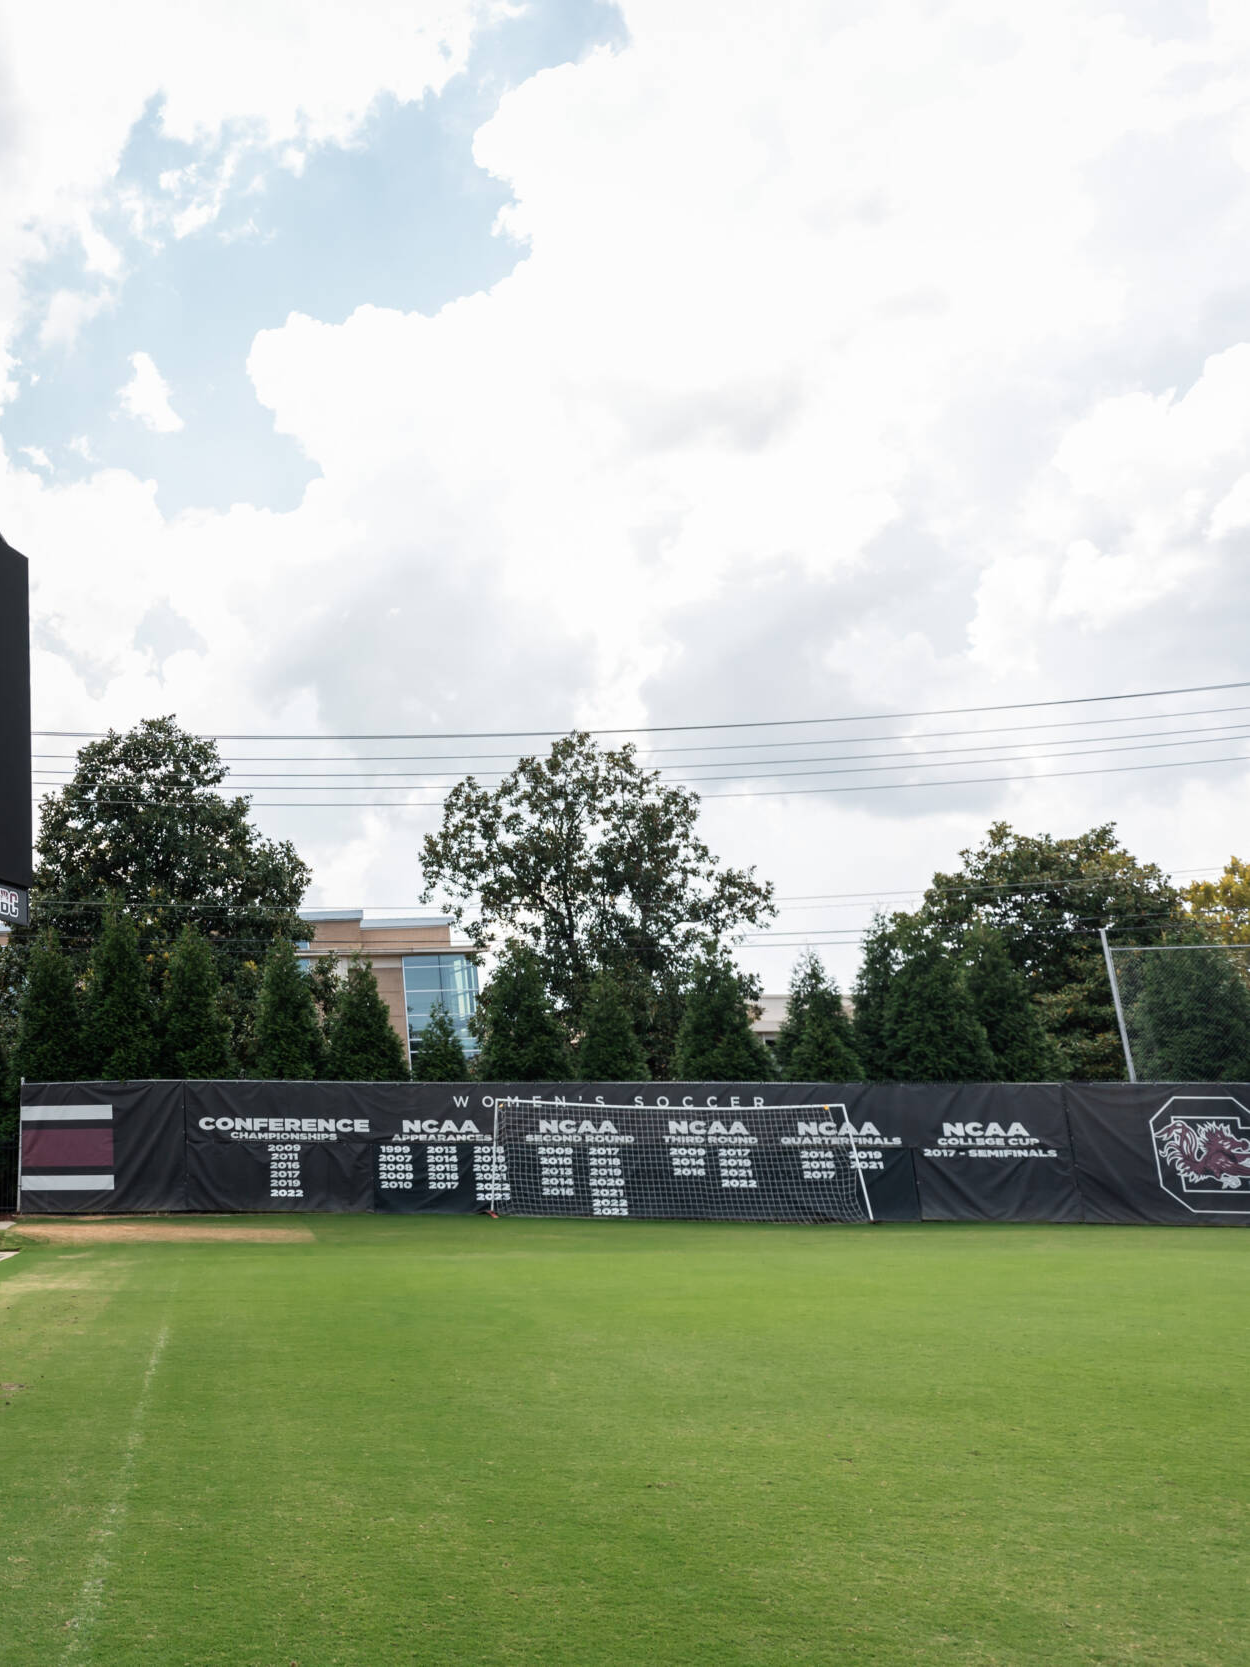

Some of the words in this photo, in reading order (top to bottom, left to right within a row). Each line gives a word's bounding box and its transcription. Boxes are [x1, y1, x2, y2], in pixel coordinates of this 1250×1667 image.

[453, 1096, 606, 1108] WOMEN'S
[634, 1096, 765, 1108] SOCCER
[199, 1117, 370, 1133] CONFERENCE
[402, 1119, 480, 1133] NCAA
[539, 1120, 618, 1134] NCAA
[668, 1121, 749, 1135] NCAA
[797, 1122, 881, 1136] NCAA
[942, 1122, 1030, 1137] NCAA
[230, 1132, 338, 1141] CHAMPIONSHIPS
[392, 1134, 492, 1142] APPEARANCES
[585, 1135, 635, 1143] ROUND
[708, 1136, 758, 1144] ROUND
[781, 1137, 902, 1145] QUARTERFINALS
[937, 1138, 1005, 1146] COLLEGE
[1008, 1138, 1040, 1146] CUP
[268, 1144, 301, 1152] 2009
[380, 1145, 410, 1153] 1999
[427, 1146, 457, 1154] 2013
[670, 1148, 706, 1156] 2009
[271, 1153, 298, 1161] 2011
[800, 1151, 834, 1159] 2014
[923, 1149, 956, 1157] 2017
[968, 1149, 1057, 1158] SEMIFINALS
[378, 1154, 412, 1162] 2007
[427, 1155, 458, 1163] 2014
[540, 1157, 572, 1165] 2010
[672, 1158, 705, 1166] 2014
[378, 1163, 413, 1171] 2008
[428, 1164, 458, 1172] 2015
[802, 1161, 836, 1169] 2016
[378, 1172, 414, 1180] 2009
[428, 1172, 459, 1180] 2016
[475, 1172, 507, 1180] 2021
[590, 1168, 622, 1176] 2019
[673, 1168, 706, 1176] 2016
[720, 1169, 753, 1177] 2021
[803, 1171, 836, 1179] 2017
[381, 1181, 412, 1189] 2010
[542, 1178, 574, 1186] 2014
[722, 1180, 757, 1188] 2022
[476, 1183, 510, 1191] 2022
[270, 1189, 303, 1197] 2022
[592, 1189, 624, 1197] 2021
[593, 1199, 628, 1207] 2022
